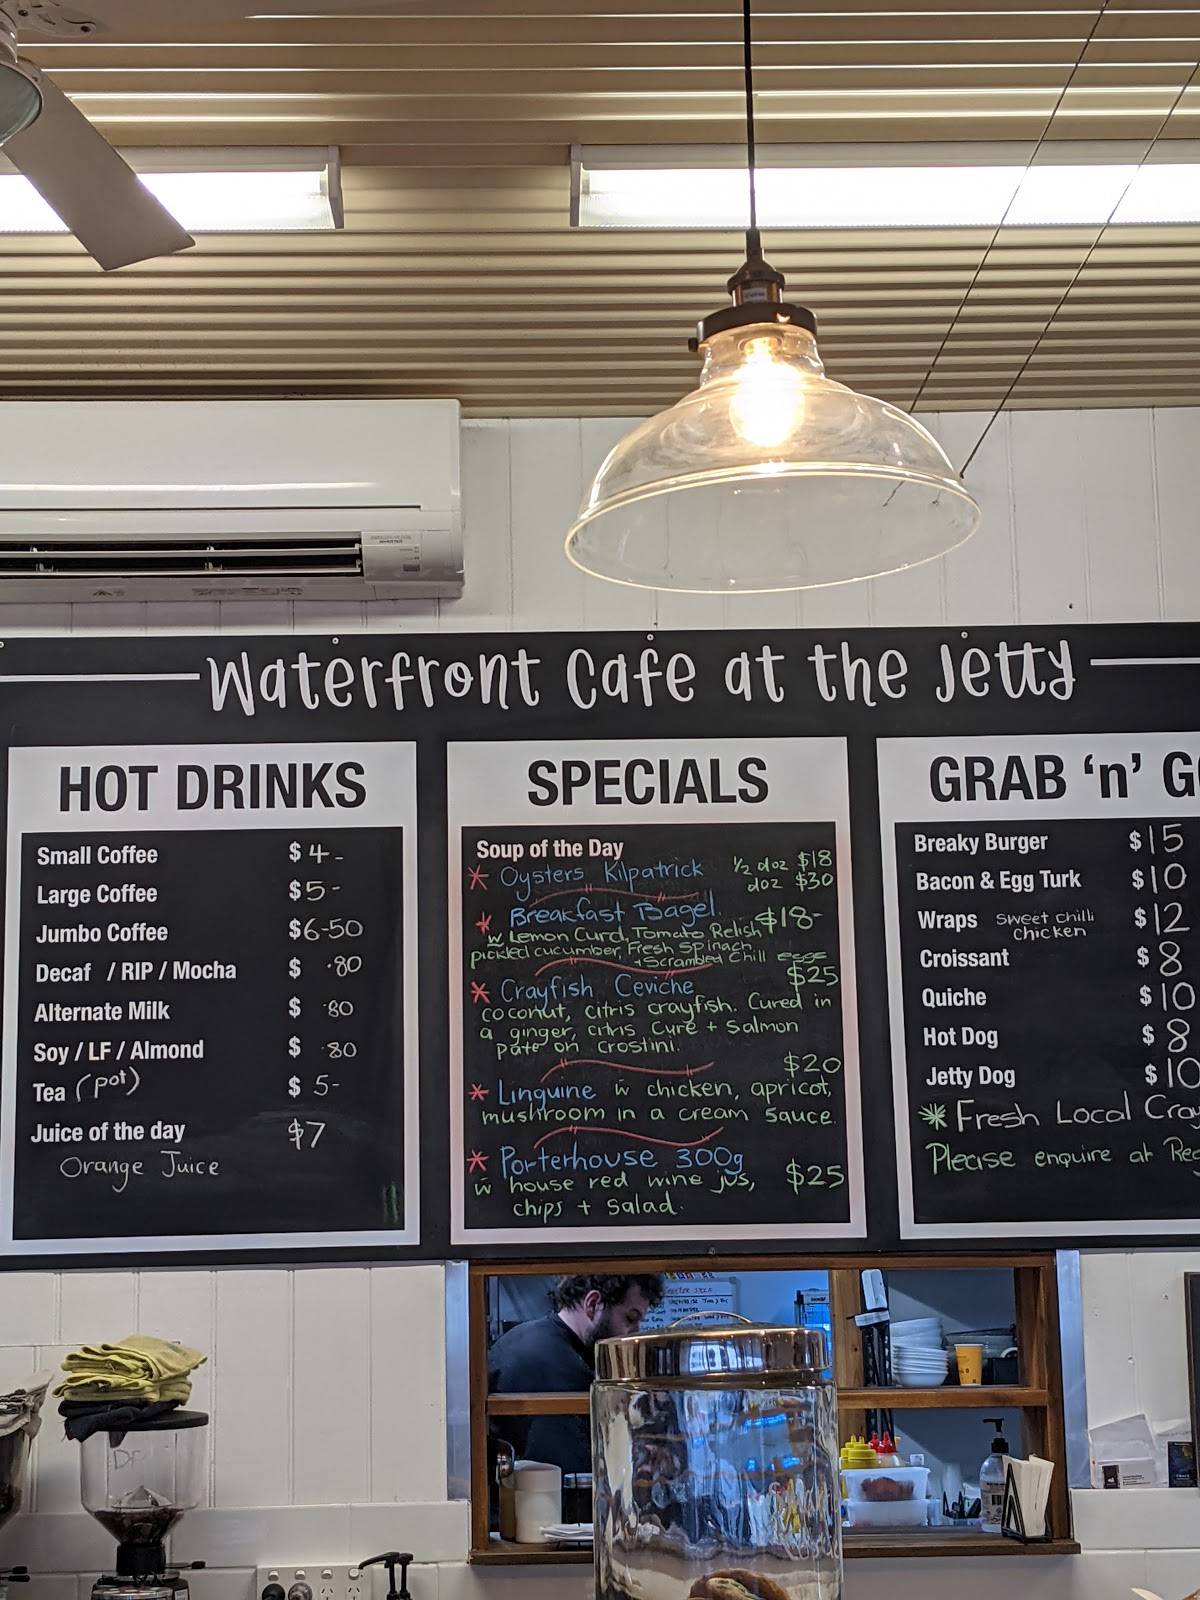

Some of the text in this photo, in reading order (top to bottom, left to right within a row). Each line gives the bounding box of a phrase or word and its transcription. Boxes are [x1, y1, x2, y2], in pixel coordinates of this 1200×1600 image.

[206, 648, 541, 716] Waterfront
[567, 648, 696, 710] Cafe
[724, 645, 785, 702] at
[808, 641, 908, 707] the
[59, 761, 367, 812] HOT DRINKS
[528, 757, 769, 806] SPECIALS
[930, 755, 1067, 802] GRAB
[1163, 751, 1200, 797] G
[37, 845, 91, 865] Small
[97, 845, 158, 864] Coffee
[476, 838, 624, 862] Soup of the Day
[914, 833, 979, 855] Breaky
[985, 832, 1048, 854] Burger
[500, 864, 585, 901] Oysters
[604, 857, 704, 893] Kilpatrick
[757, 857, 789, 873] doz
[797, 849, 833, 871] $18
[747, 871, 834, 893] doz $30
[916, 871, 974, 891] Bacon
[980, 871, 995, 889] &
[1000, 871, 1034, 892] Egg
[1039, 869, 1082, 888] Turk
[37, 884, 91, 908] Large
[97, 883, 158, 903] Coffee
[510, 896, 625, 927] Breakfast
[918, 910, 978, 932] Wraps
[36, 924, 102, 944] Jumbo
[107, 923, 168, 943] Coffee
[509, 929, 570, 945] Lemon
[631, 926, 705, 939] Tomato
[709, 920, 763, 940] Relish
[1013, 925, 1087, 941] chicken
[470, 944, 530, 969] pickled
[627, 941, 675, 956] Fresh
[920, 948, 1010, 968] Croissant
[36, 962, 91, 983] Decaf
[121, 961, 154, 981] RIP
[173, 960, 237, 980] Mocha
[500, 961, 840, 1012] Crayfish Ceviche $25
[922, 987, 987, 1009] Quiche
[34, 1002, 122, 1023] Alternate
[129, 1000, 170, 1020] Milk
[482, 1003, 571, 1022] coconut,
[585, 1000, 636, 1019] citris
[814, 992, 832, 1009] in
[479, 1026, 494, 1040] a
[509, 1023, 577, 1047] ginger,
[587, 1021, 636, 1037] citris
[923, 1026, 956, 1047] Hot
[962, 1026, 998, 1049] Dog
[34, 1042, 69, 1065] Soy
[89, 1041, 111, 1061] LF
[130, 1040, 204, 1060] Almond
[496, 1040, 540, 1060] pate
[553, 1041, 579, 1053] on
[783, 1051, 842, 1078] $20
[926, 1066, 973, 1089] Jetty
[979, 1065, 1015, 1088] Dog
[33, 1082, 66, 1102] Tea
[498, 1079, 597, 1112] Linguine
[647, 1077, 740, 1101] chicken,
[750, 1074, 832, 1105] apricot,
[481, 1102, 605, 1126] mushroom
[617, 1107, 636, 1122] in
[650, 1107, 665, 1120] a
[678, 1106, 749, 1121] cream
[956, 1099, 1040, 1132] Fresh
[1057, 1090, 1132, 1124] Local
[31, 1117, 326, 1150] Juice of the day $7
[500, 1140, 845, 1195] Porterhouse 300g $25
[925, 1142, 1017, 1175] Please
[1034, 1145, 1113, 1168] enquire
[1129, 1140, 1154, 1163] at
[60, 1150, 219, 1192] Orange Juice
[510, 1175, 574, 1194] house
[589, 1171, 629, 1188] red
[647, 1173, 703, 1188] wine
[513, 1198, 564, 1224] chips
[577, 1199, 591, 1215] +
